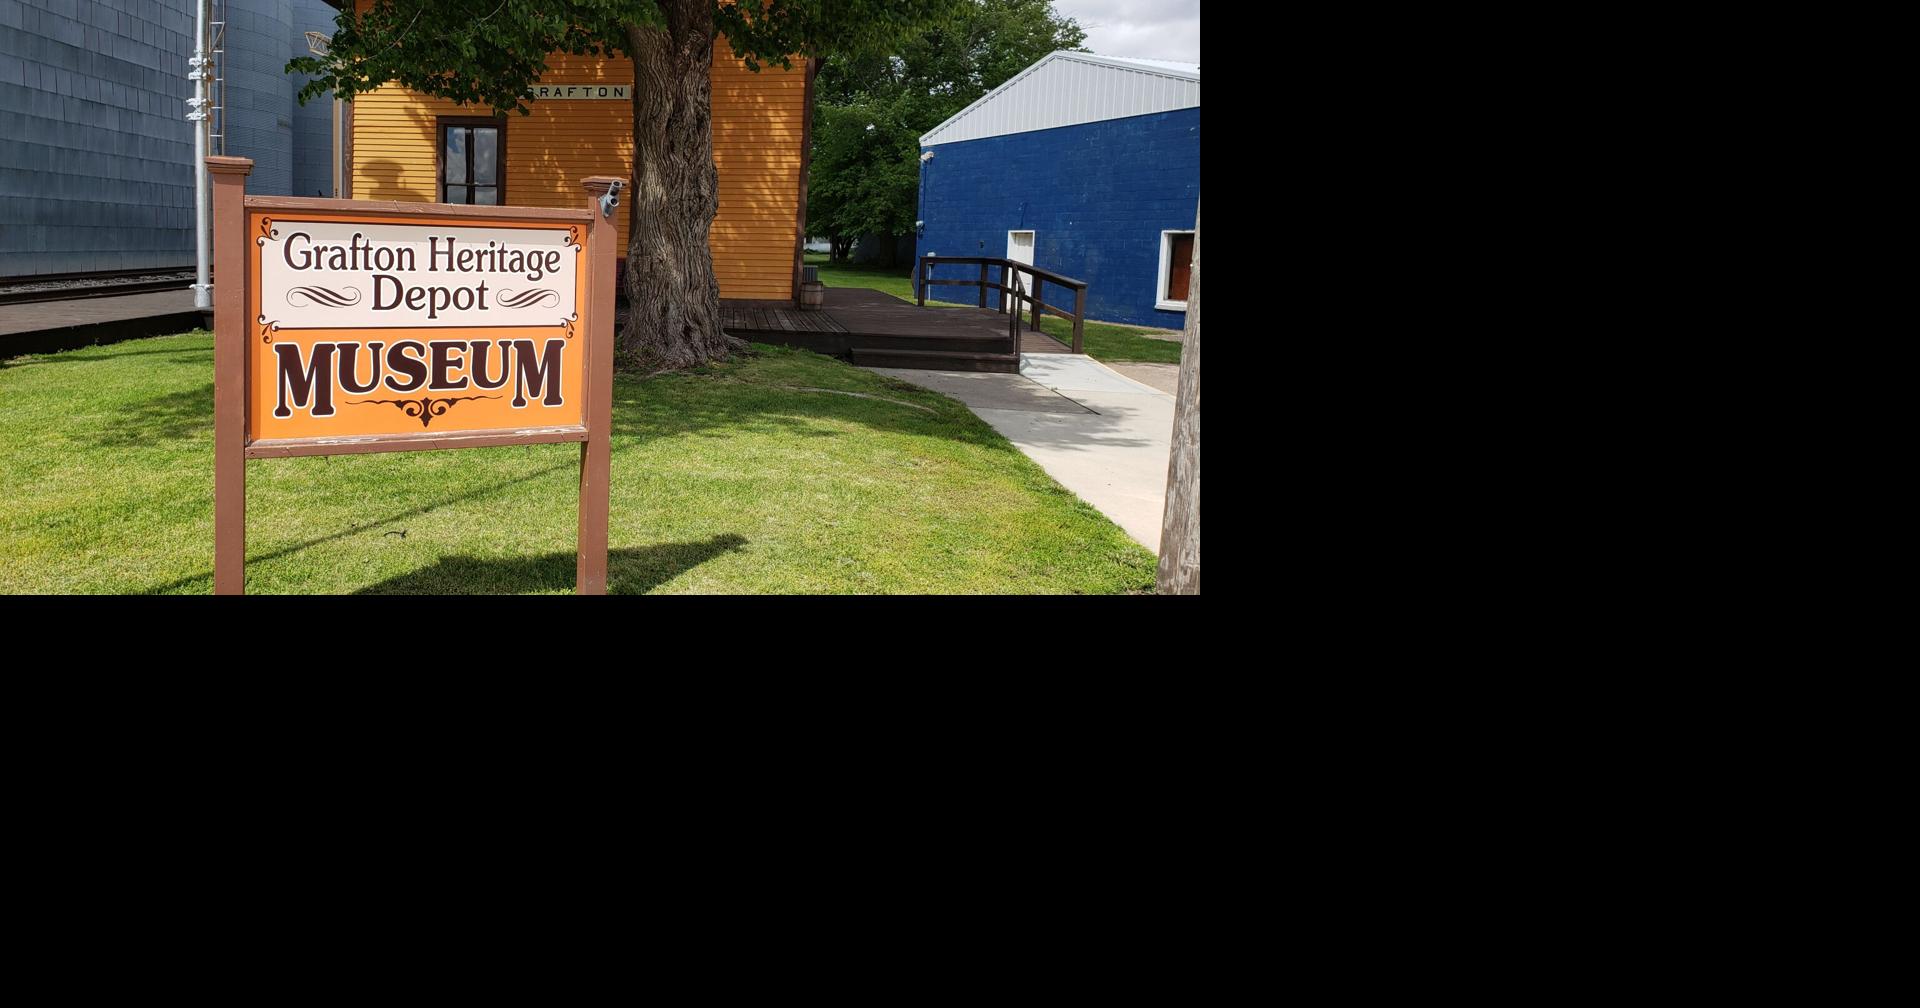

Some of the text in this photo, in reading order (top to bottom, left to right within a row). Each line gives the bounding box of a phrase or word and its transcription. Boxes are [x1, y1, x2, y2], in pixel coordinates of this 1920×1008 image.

[283, 231, 562, 282] Grafton Heritage
[371, 273, 490, 320] Depot
[272, 338, 566, 418] MUSEUM
